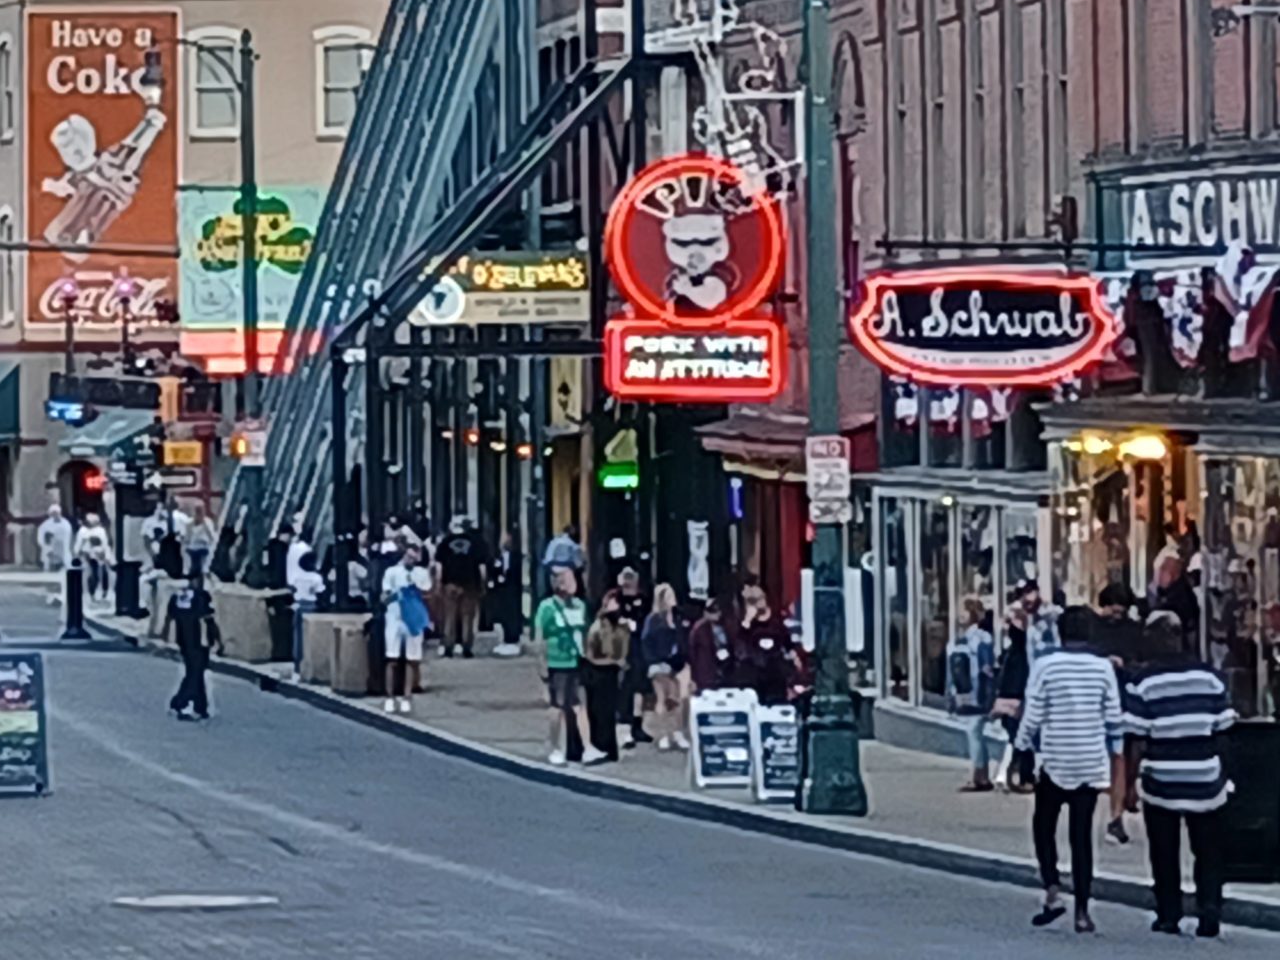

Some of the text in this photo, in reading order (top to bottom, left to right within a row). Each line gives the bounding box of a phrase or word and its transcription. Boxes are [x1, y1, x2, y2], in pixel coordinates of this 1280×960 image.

[51, 20, 152, 48] Have a
[39, 271, 170, 319] Cca-Cla
[921, 286, 1093, 338] Schwab
